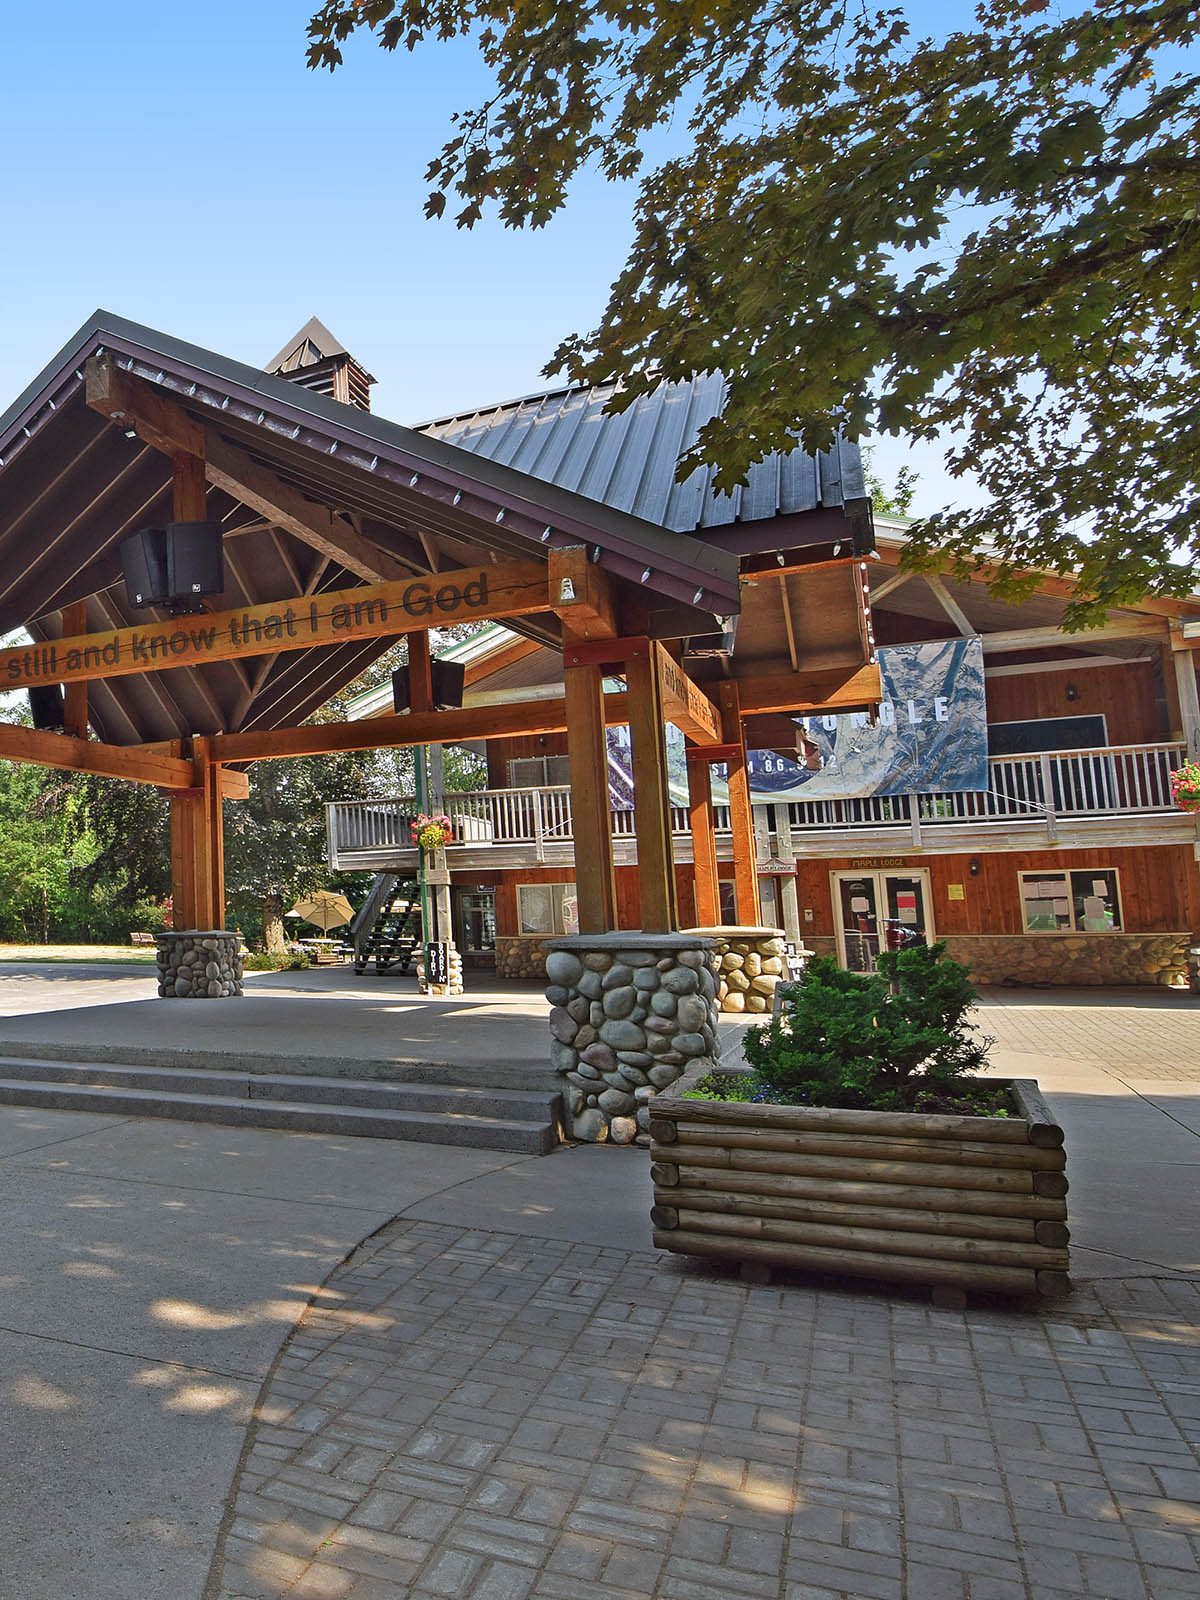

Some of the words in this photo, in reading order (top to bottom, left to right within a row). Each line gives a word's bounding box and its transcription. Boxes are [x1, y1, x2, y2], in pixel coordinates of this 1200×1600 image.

[7, 646, 57, 679] still
[65, 634, 120, 670] and
[132, 626, 216, 661] know
[228, 607, 297, 646] that
[310, 601, 318, 633] I
[331, 598, 388, 629] am
[402, 572, 489, 617] God
[880, 858, 905, 867] LODGE
